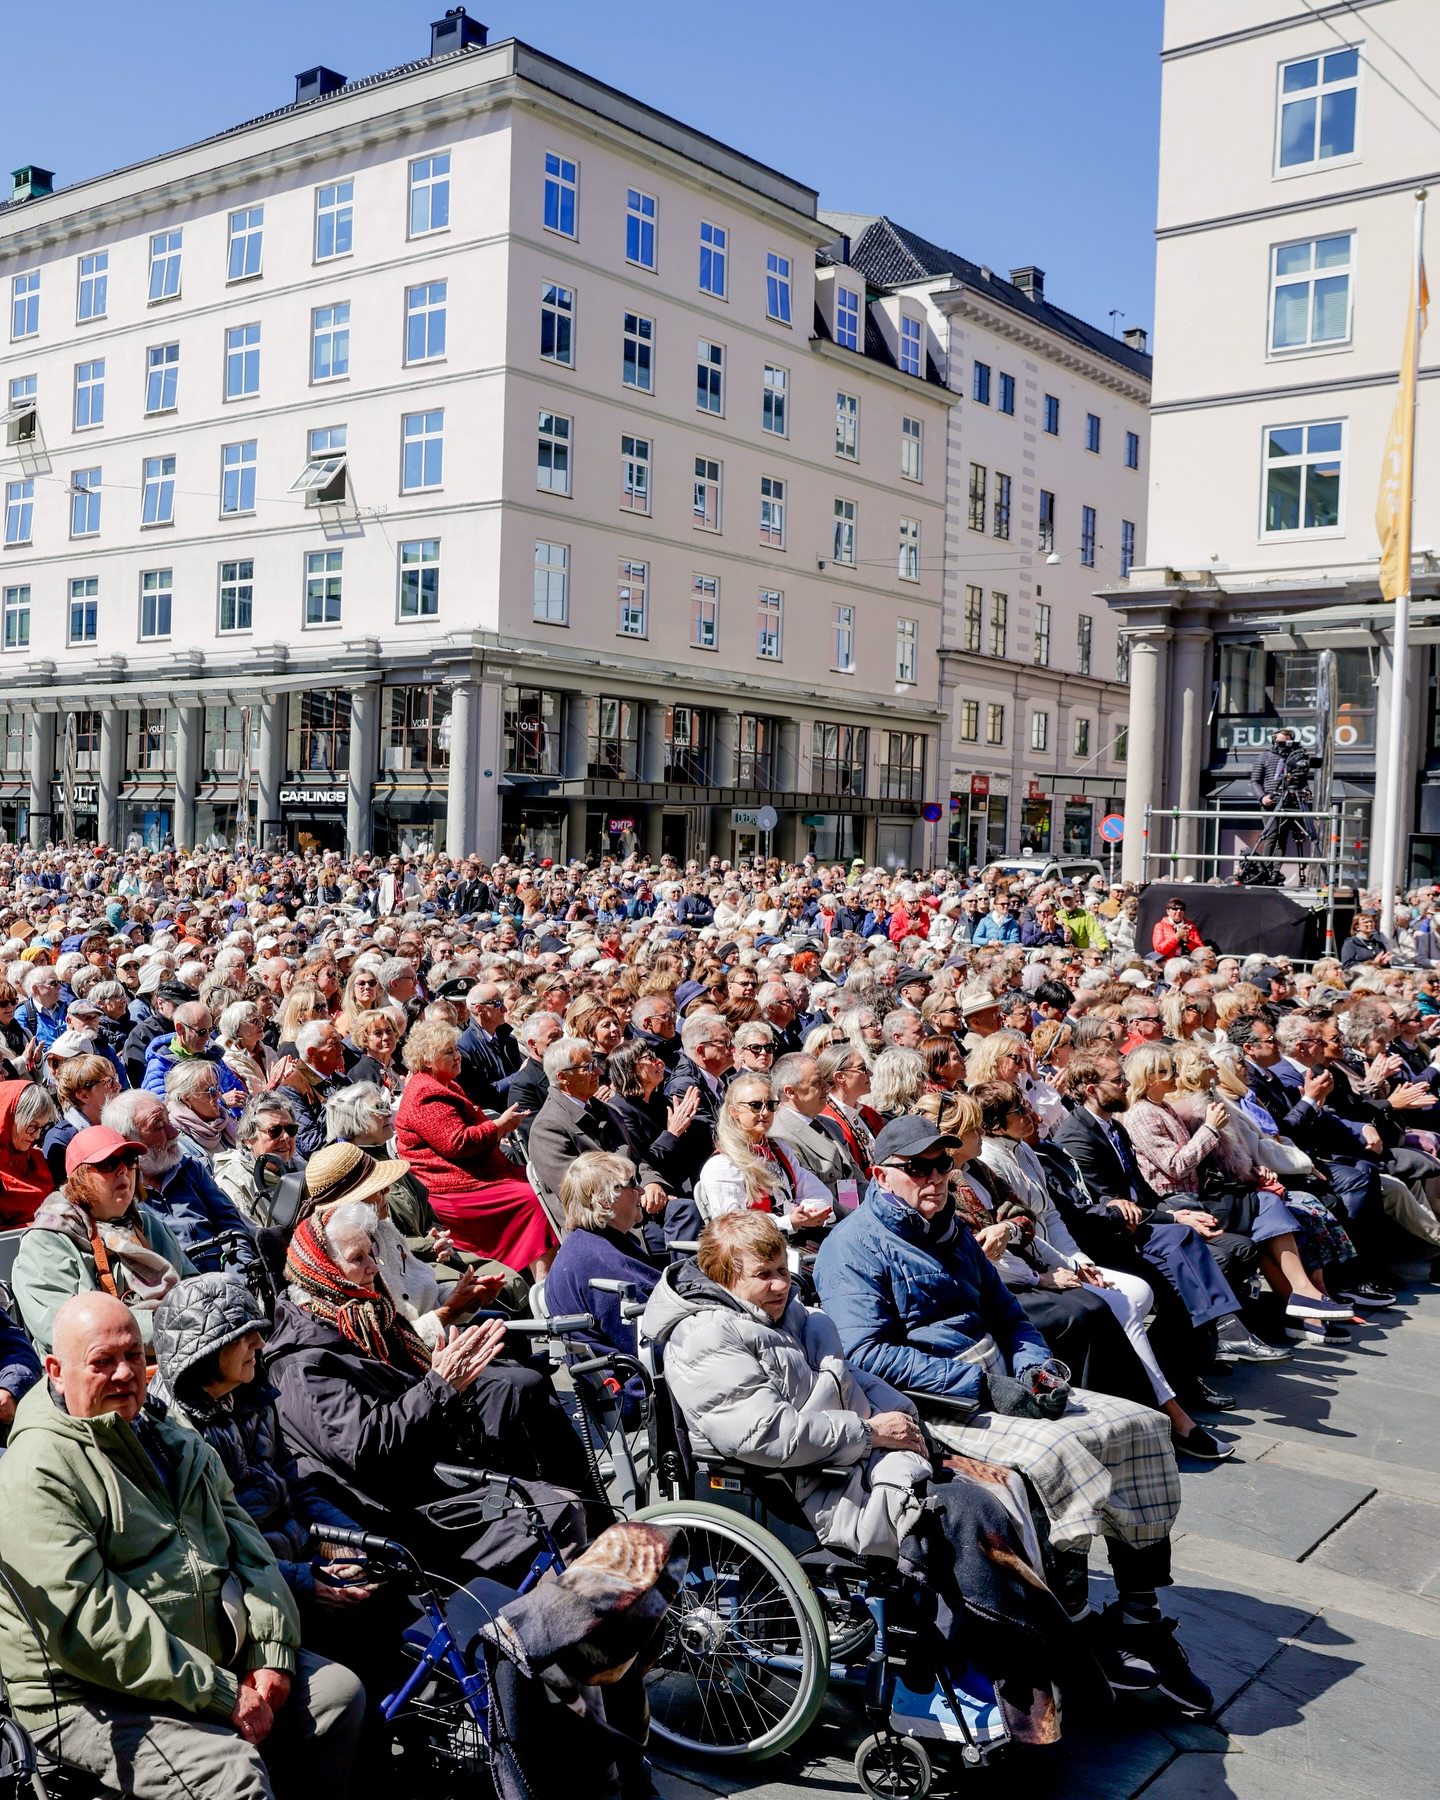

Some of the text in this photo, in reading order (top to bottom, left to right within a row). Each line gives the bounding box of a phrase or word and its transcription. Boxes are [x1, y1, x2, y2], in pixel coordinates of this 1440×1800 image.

[412, 718, 430, 728] VOLT
[514, 721, 540, 731] VOLT
[147, 724, 165, 733] VOLT
[673, 737, 690, 745] VOLT
[1232, 725, 1358, 747] EUOSO
[740, 744, 755, 753] VOLT
[279, 790, 346, 803] CARLINGS
